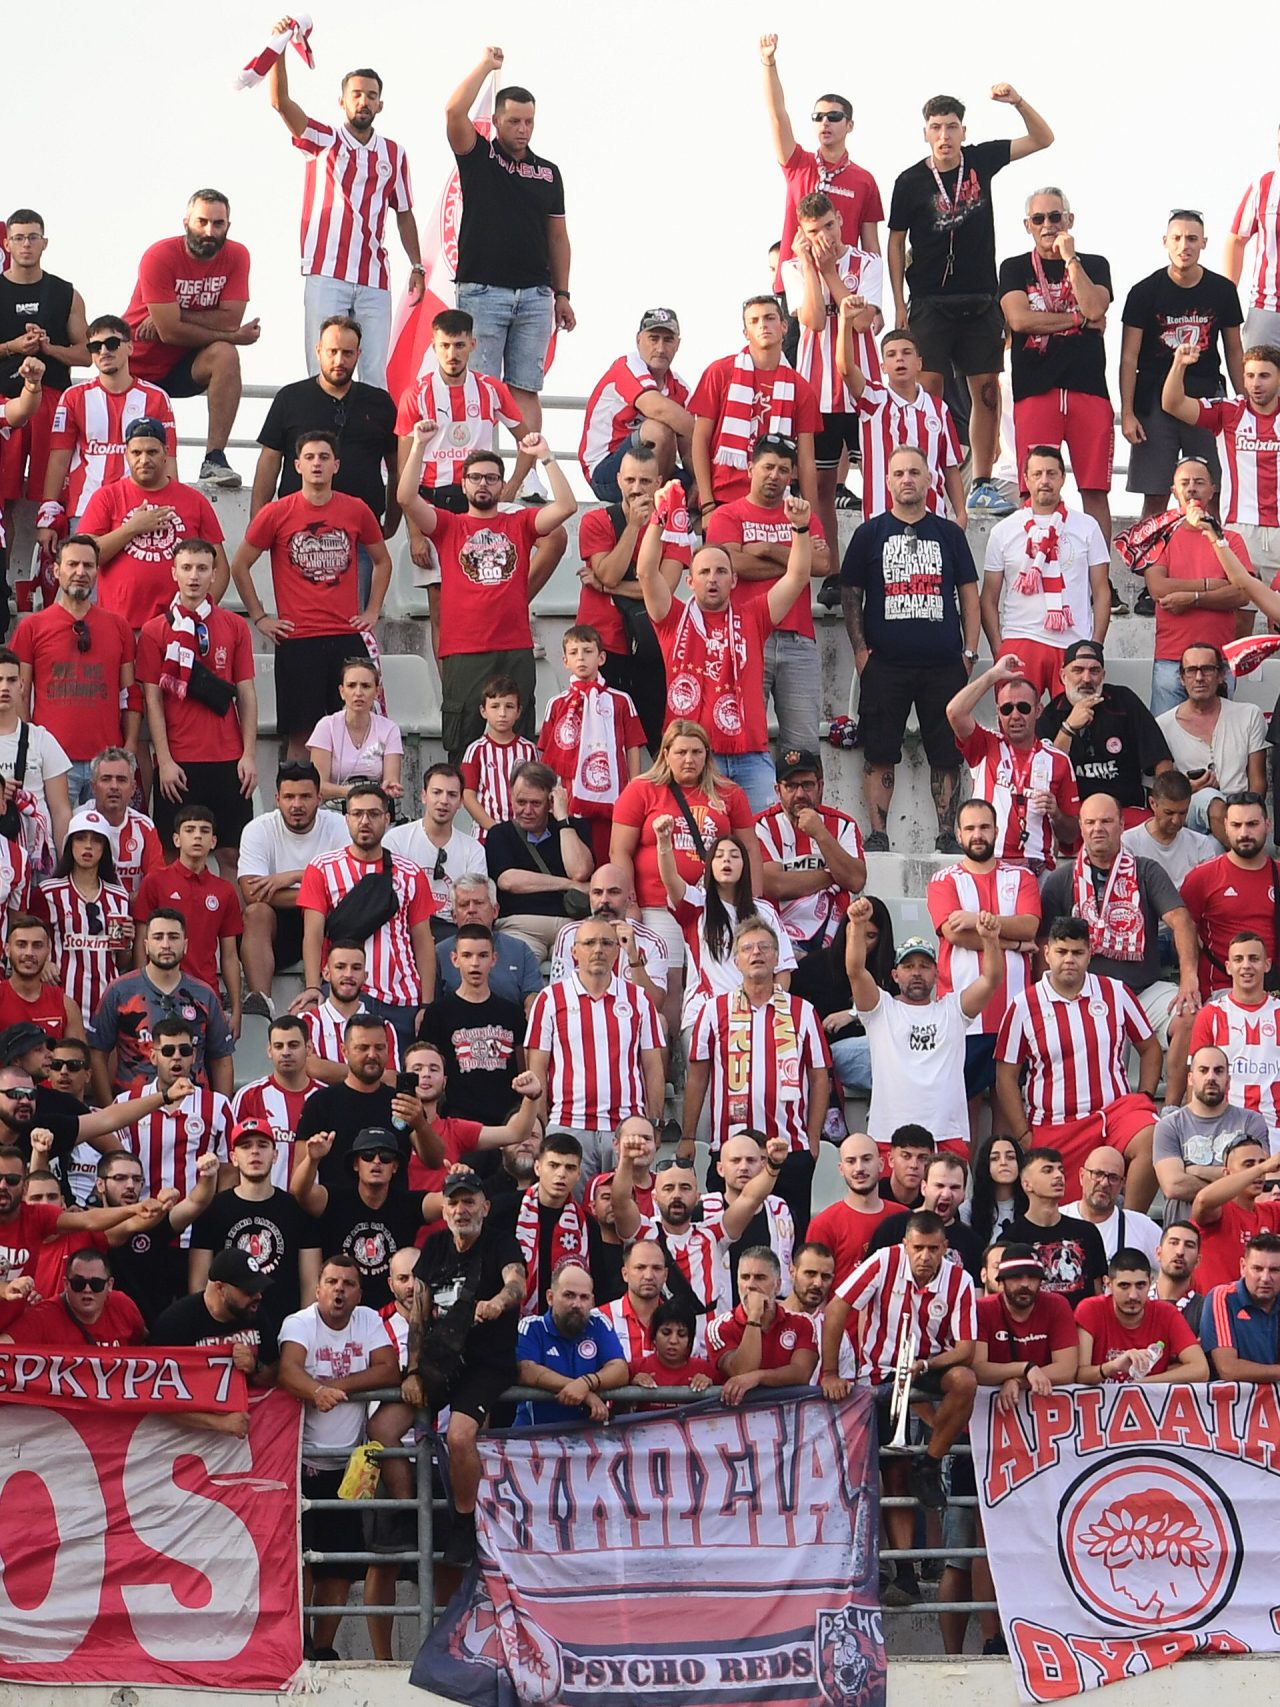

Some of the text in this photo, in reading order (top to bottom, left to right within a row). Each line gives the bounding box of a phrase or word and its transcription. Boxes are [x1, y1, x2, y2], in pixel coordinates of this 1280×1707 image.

[65, 934, 110, 951] Stoixim
[910, 1043, 936, 1052] WAR
[207, 1356, 233, 1402] 7
[563, 1650, 814, 1689] PSYCHO REDS
